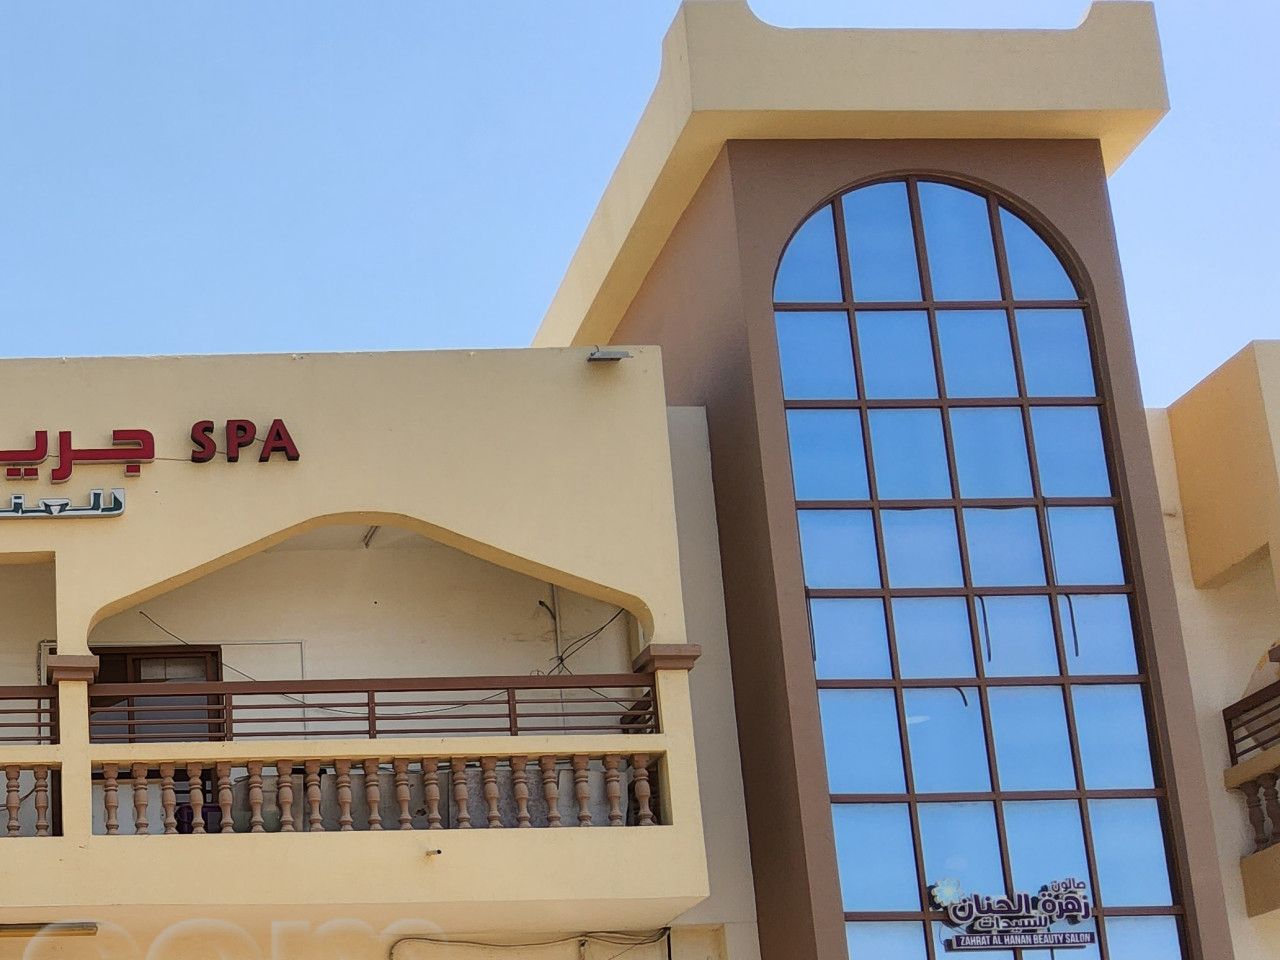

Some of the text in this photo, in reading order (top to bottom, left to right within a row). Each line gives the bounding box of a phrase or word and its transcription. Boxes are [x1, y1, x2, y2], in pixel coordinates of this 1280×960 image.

[190, 418, 300, 463] SPA
[1050, 878, 1087, 892] صالون
[951, 892, 1091, 922] زهرة الحنان
[977, 916, 1049, 932] للسيدات
[960, 933, 1091, 946] ZAHRAT AL HANAN BEAUTY SALON
